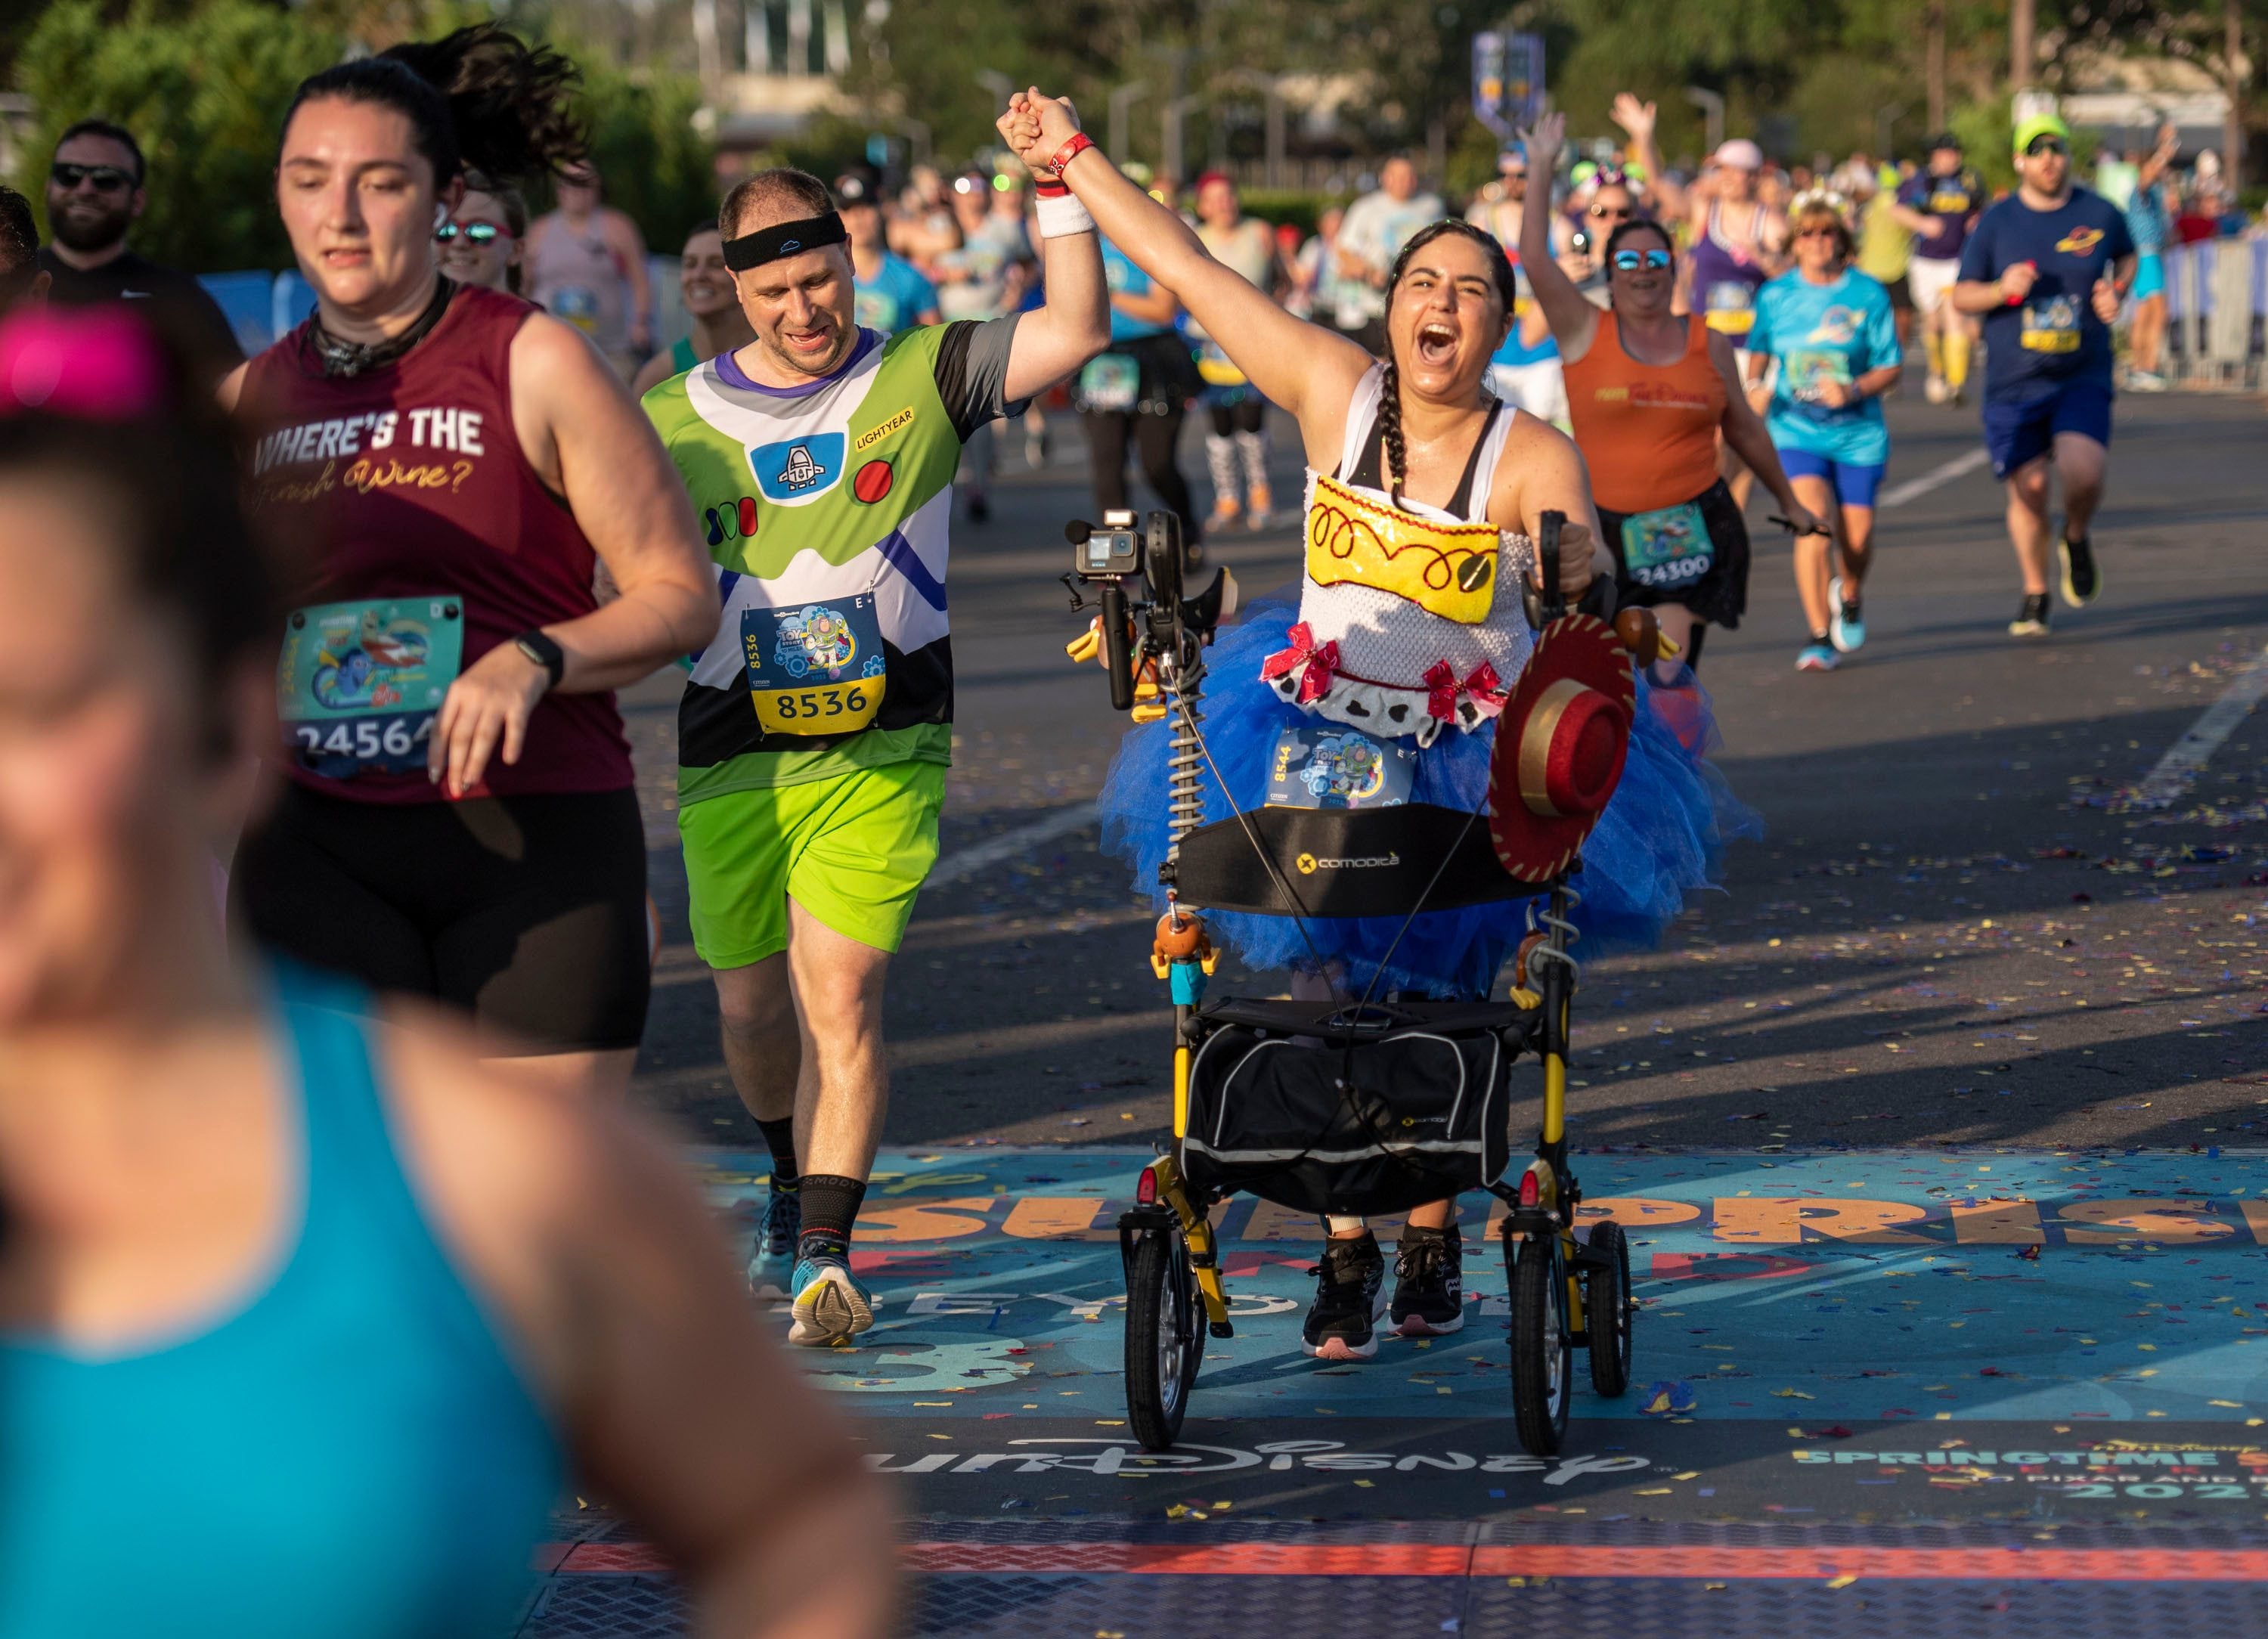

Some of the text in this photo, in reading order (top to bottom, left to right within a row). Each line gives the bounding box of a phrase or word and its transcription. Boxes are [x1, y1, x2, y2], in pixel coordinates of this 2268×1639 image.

[857, 411, 912, 449] LIGHTYEAR
[254, 407, 485, 478] WHERE'S THE
[429, 603, 442, 618] D
[855, 597, 863, 609] E
[778, 628, 802, 642] TOY
[745, 634, 761, 670] 8536
[777, 686, 867, 719] 8536
[1313, 748, 1337, 761] TOY
[1397, 748, 1405, 759] E
[1274, 745, 1292, 782] 8544
[1796, 1451, 2220, 1466] SPRINGTIME
[2152, 1475, 2238, 1483] AND
[2062, 1483, 2268, 1499] 202
